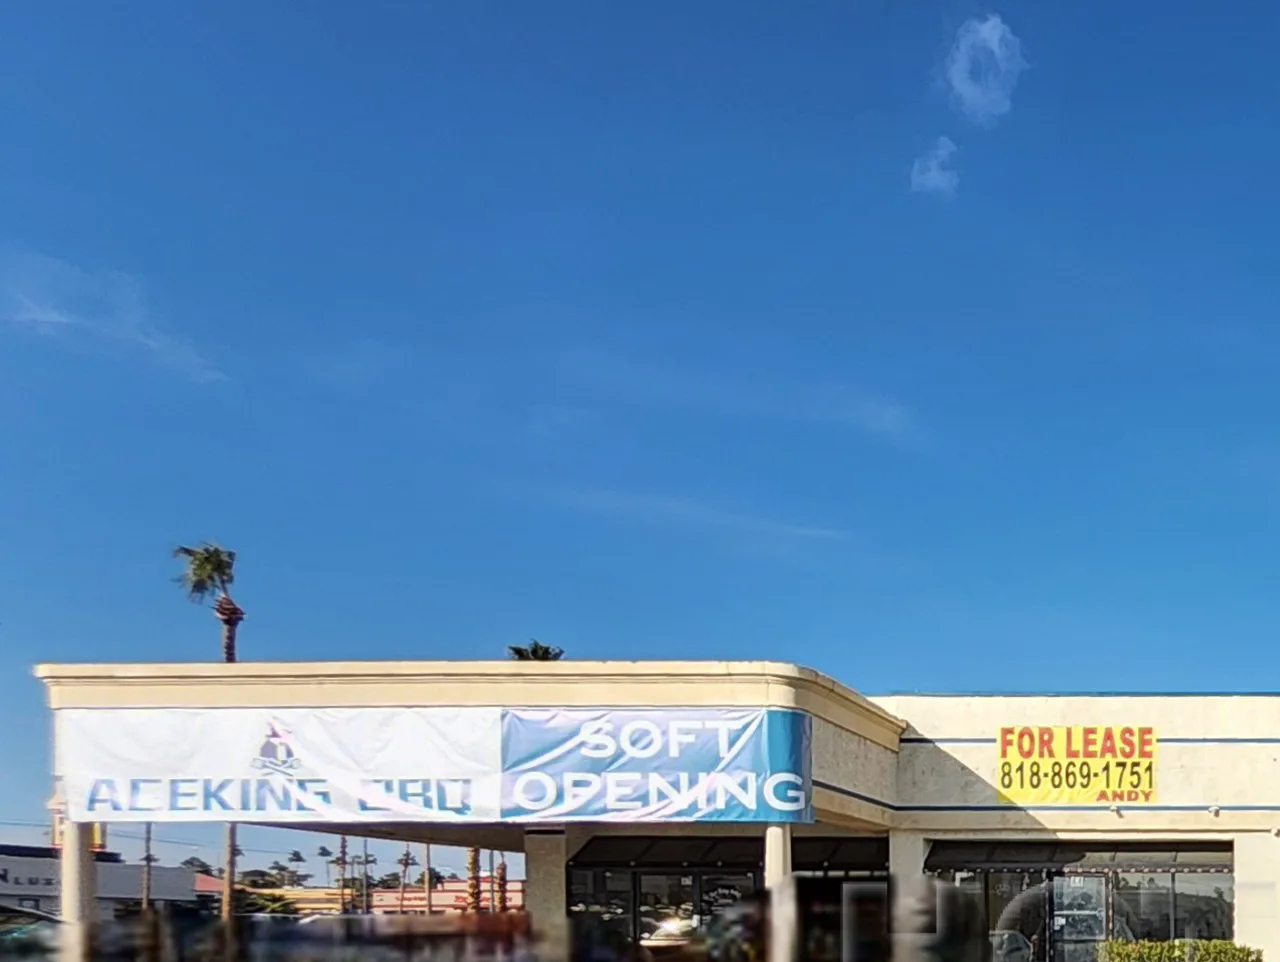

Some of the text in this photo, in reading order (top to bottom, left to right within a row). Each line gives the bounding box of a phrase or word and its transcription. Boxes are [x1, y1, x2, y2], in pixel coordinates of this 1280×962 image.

[578, 719, 742, 758] SOFT
[1001, 727, 1154, 758] FOR LEASE
[1001, 761, 1154, 789] 818-869-1751
[513, 771, 806, 811] OPENING
[1096, 790, 1154, 802] ANDY
